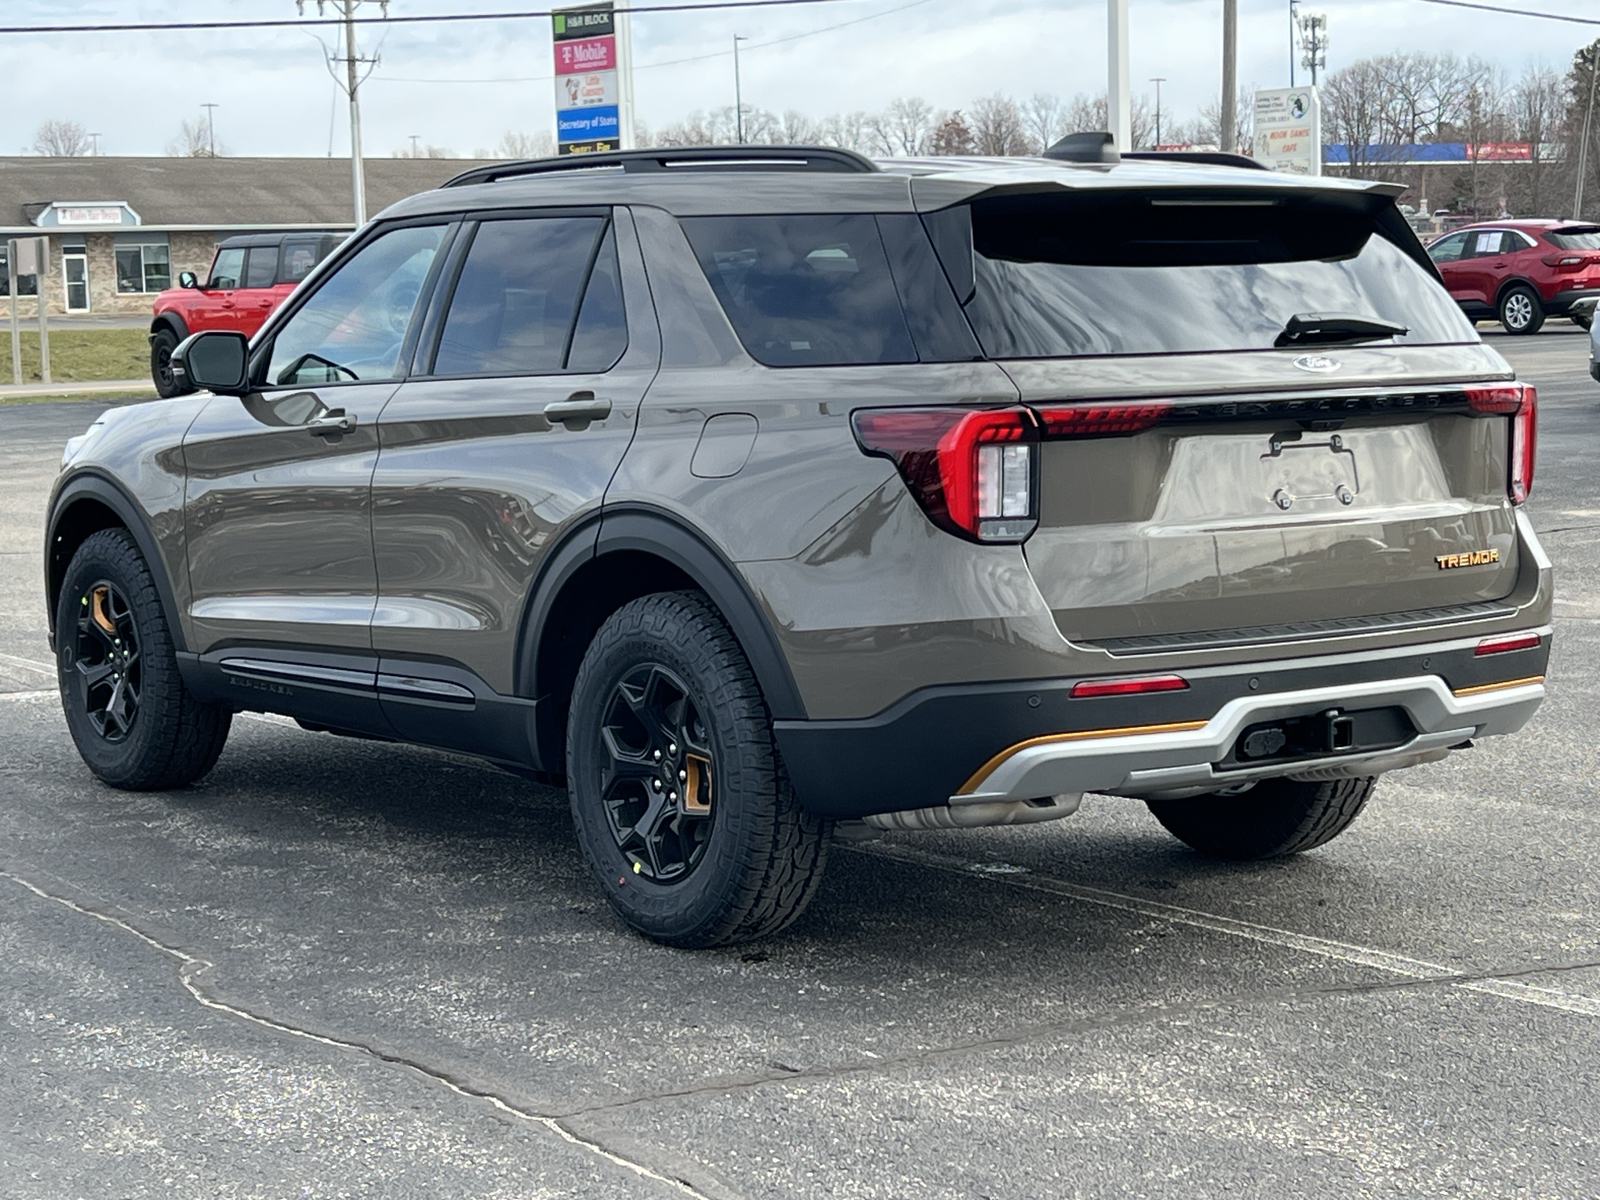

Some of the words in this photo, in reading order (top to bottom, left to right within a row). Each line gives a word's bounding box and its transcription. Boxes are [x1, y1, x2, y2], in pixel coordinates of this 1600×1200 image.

[567, 16, 583, 28] H&R
[584, 13, 610, 26] BLOCK
[573, 43, 607, 62] Mobile
[559, 119, 590, 131] Secretary
[591, 116, 599, 127] of
[599, 116, 617, 127] State
[1435, 548, 1500, 570] TREMOR
